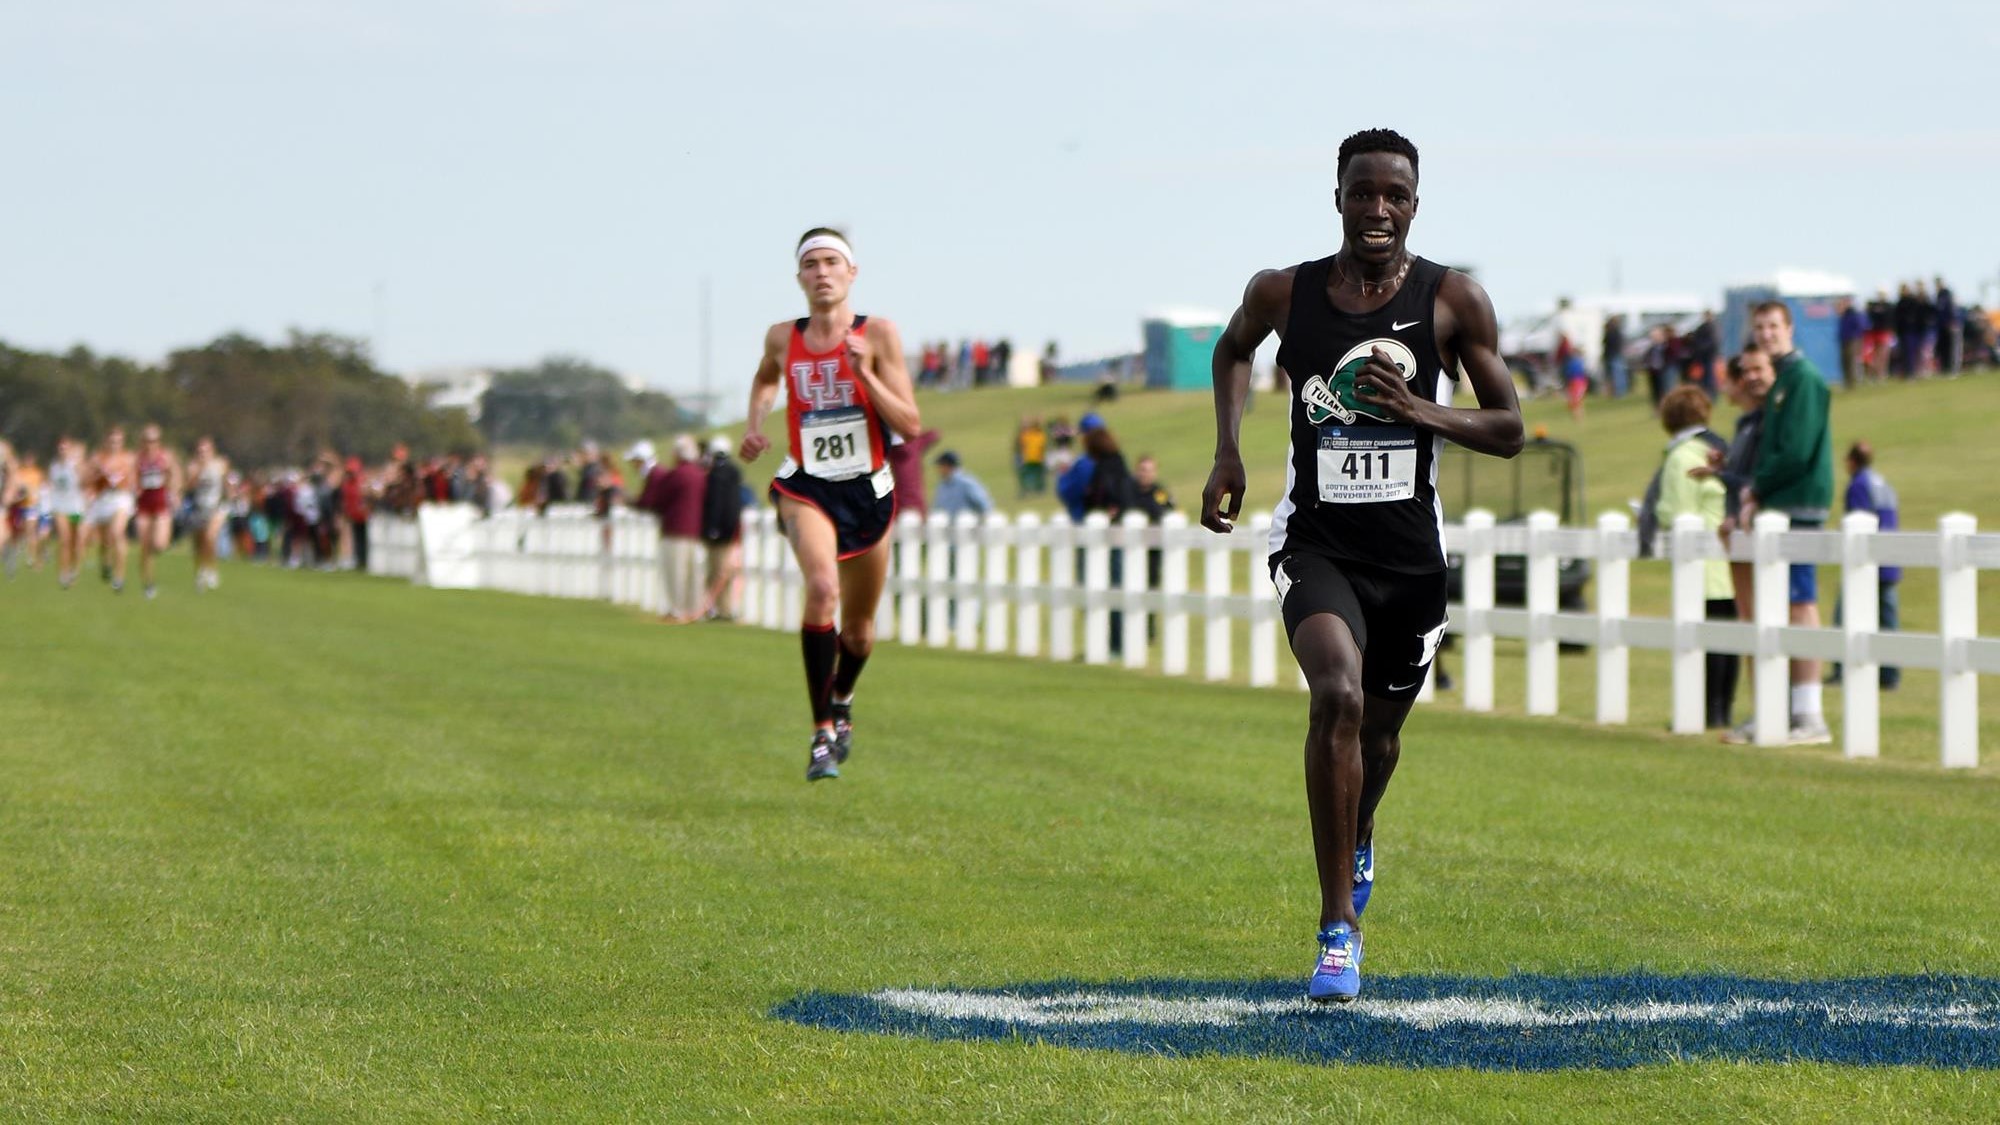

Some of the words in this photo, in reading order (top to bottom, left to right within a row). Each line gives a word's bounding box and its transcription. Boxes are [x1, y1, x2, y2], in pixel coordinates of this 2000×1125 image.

[1311, 385, 1344, 414] TULANE
[813, 433, 856, 462] 281
[1373, 439, 1415, 447] CHAMPIONSHIPS
[1341, 453, 1390, 481] 411
[1385, 481, 1409, 489] REGION
